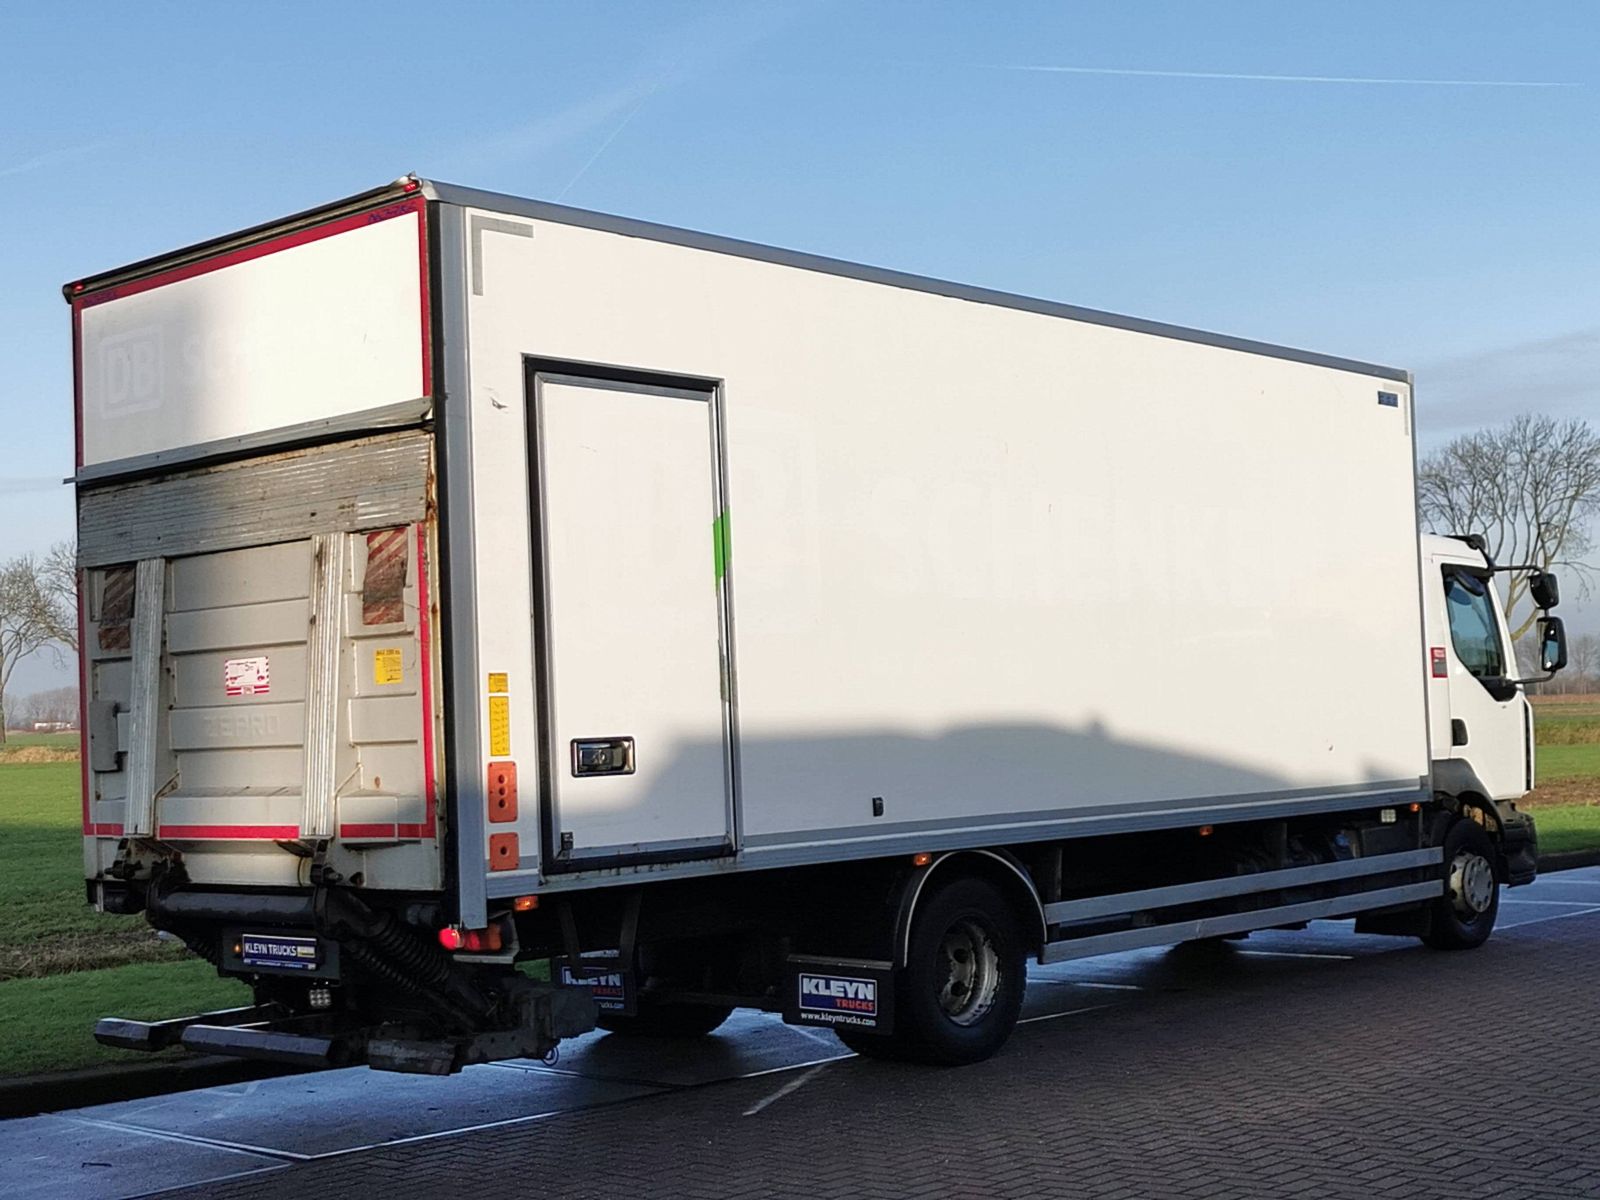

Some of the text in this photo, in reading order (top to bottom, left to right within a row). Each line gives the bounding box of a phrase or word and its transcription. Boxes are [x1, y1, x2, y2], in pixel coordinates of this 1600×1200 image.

[203, 713, 280, 737] ZEPRO
[245, 943, 267, 953] KLEYN
[268, 944, 296, 956] TRUCKS
[802, 978, 874, 1000] KLEYN
[835, 998, 874, 1011] TRUCKS
[801, 1013, 876, 1026] www.kleyntrucks.com
